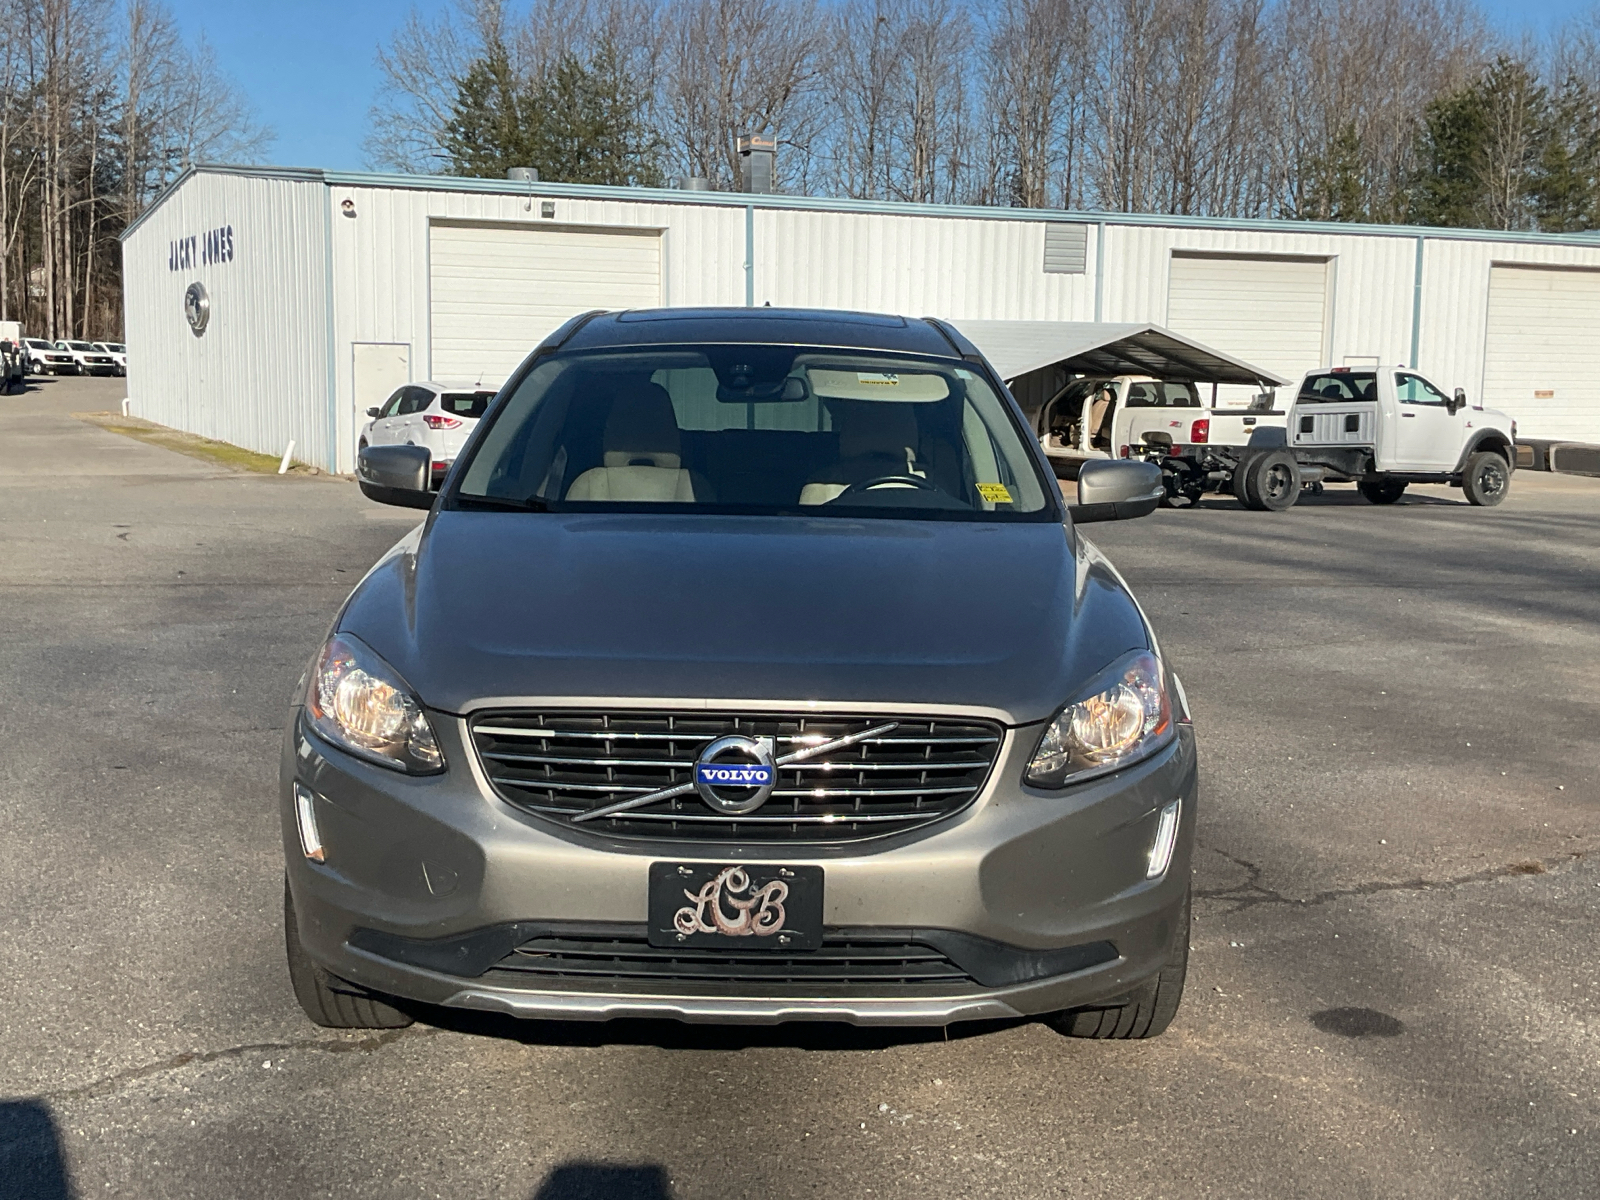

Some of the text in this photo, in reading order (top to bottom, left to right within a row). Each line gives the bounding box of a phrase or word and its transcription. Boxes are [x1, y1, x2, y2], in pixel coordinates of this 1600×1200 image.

[169, 224, 233, 271] JACKY JONES
[701, 769, 768, 780] VOLVO
